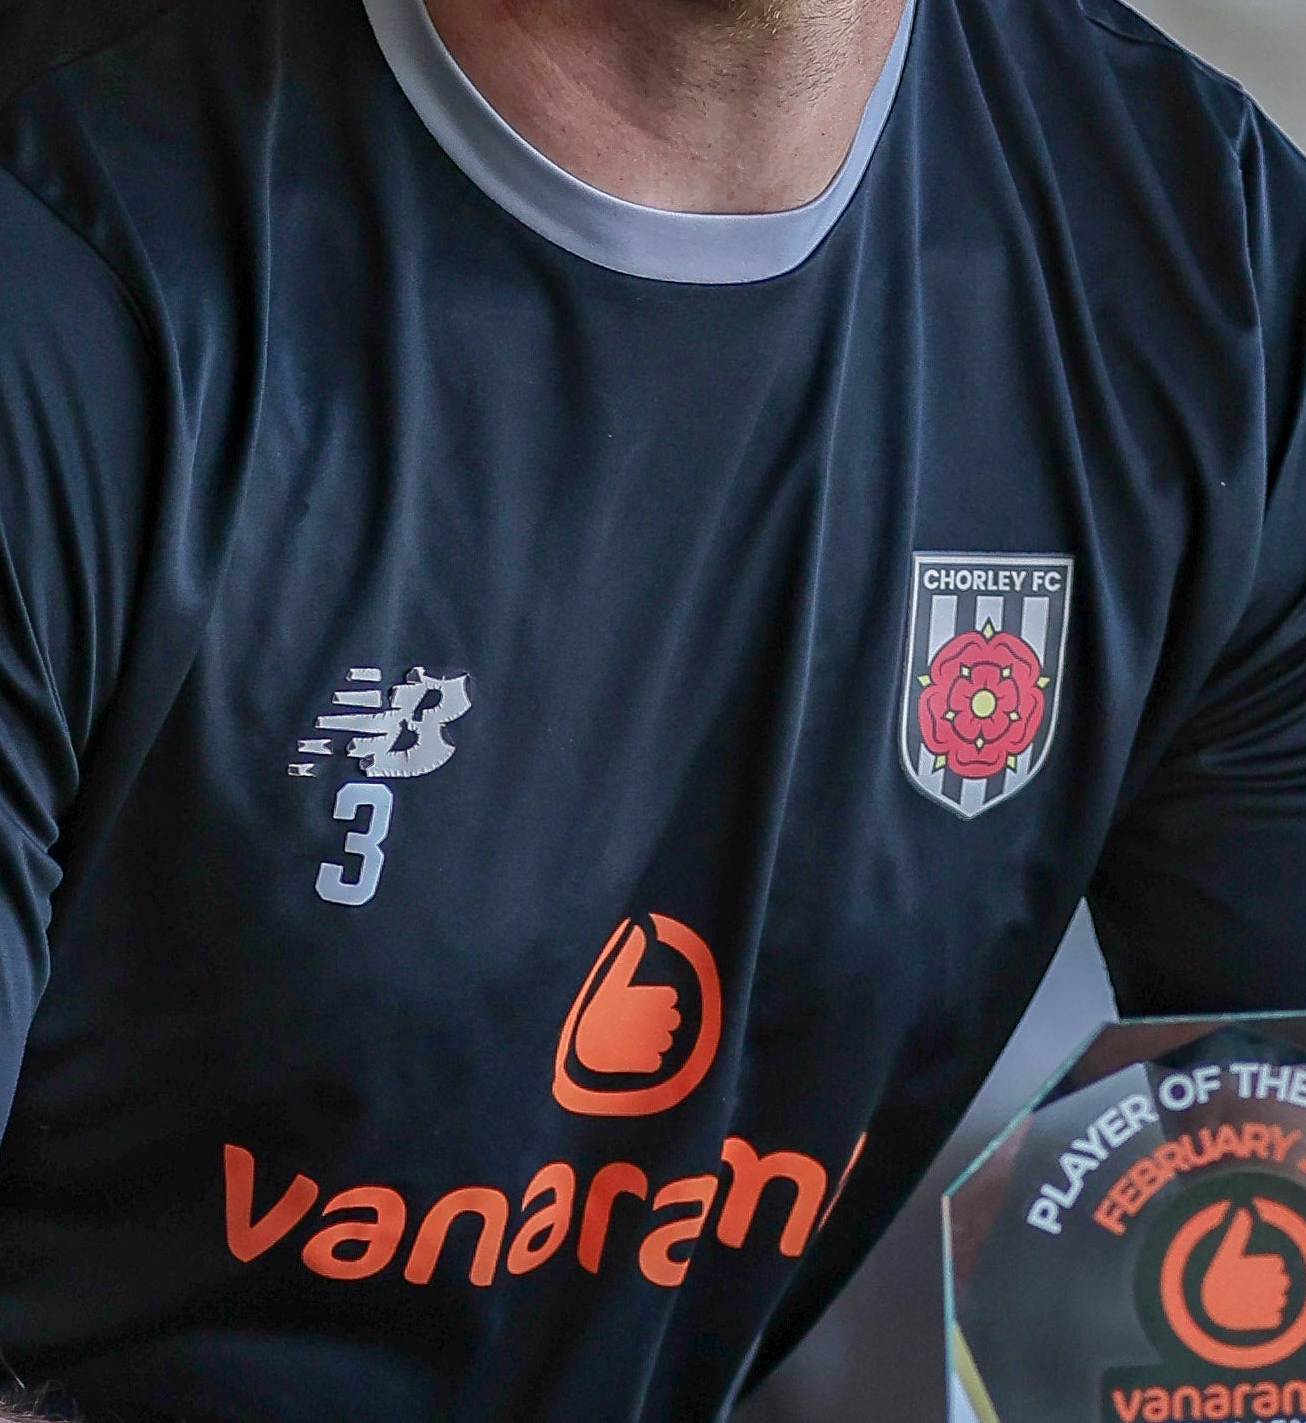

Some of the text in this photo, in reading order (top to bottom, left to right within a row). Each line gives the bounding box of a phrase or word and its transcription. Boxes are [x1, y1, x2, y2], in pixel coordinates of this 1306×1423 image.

[923, 568, 1062, 593] CHORLEY FC
[315, 781, 394, 908] 3
[1026, 1092, 1159, 1235] PLAYER
[1158, 1063, 1222, 1111] OF
[1093, 1122, 1301, 1236] FEBRUARY
